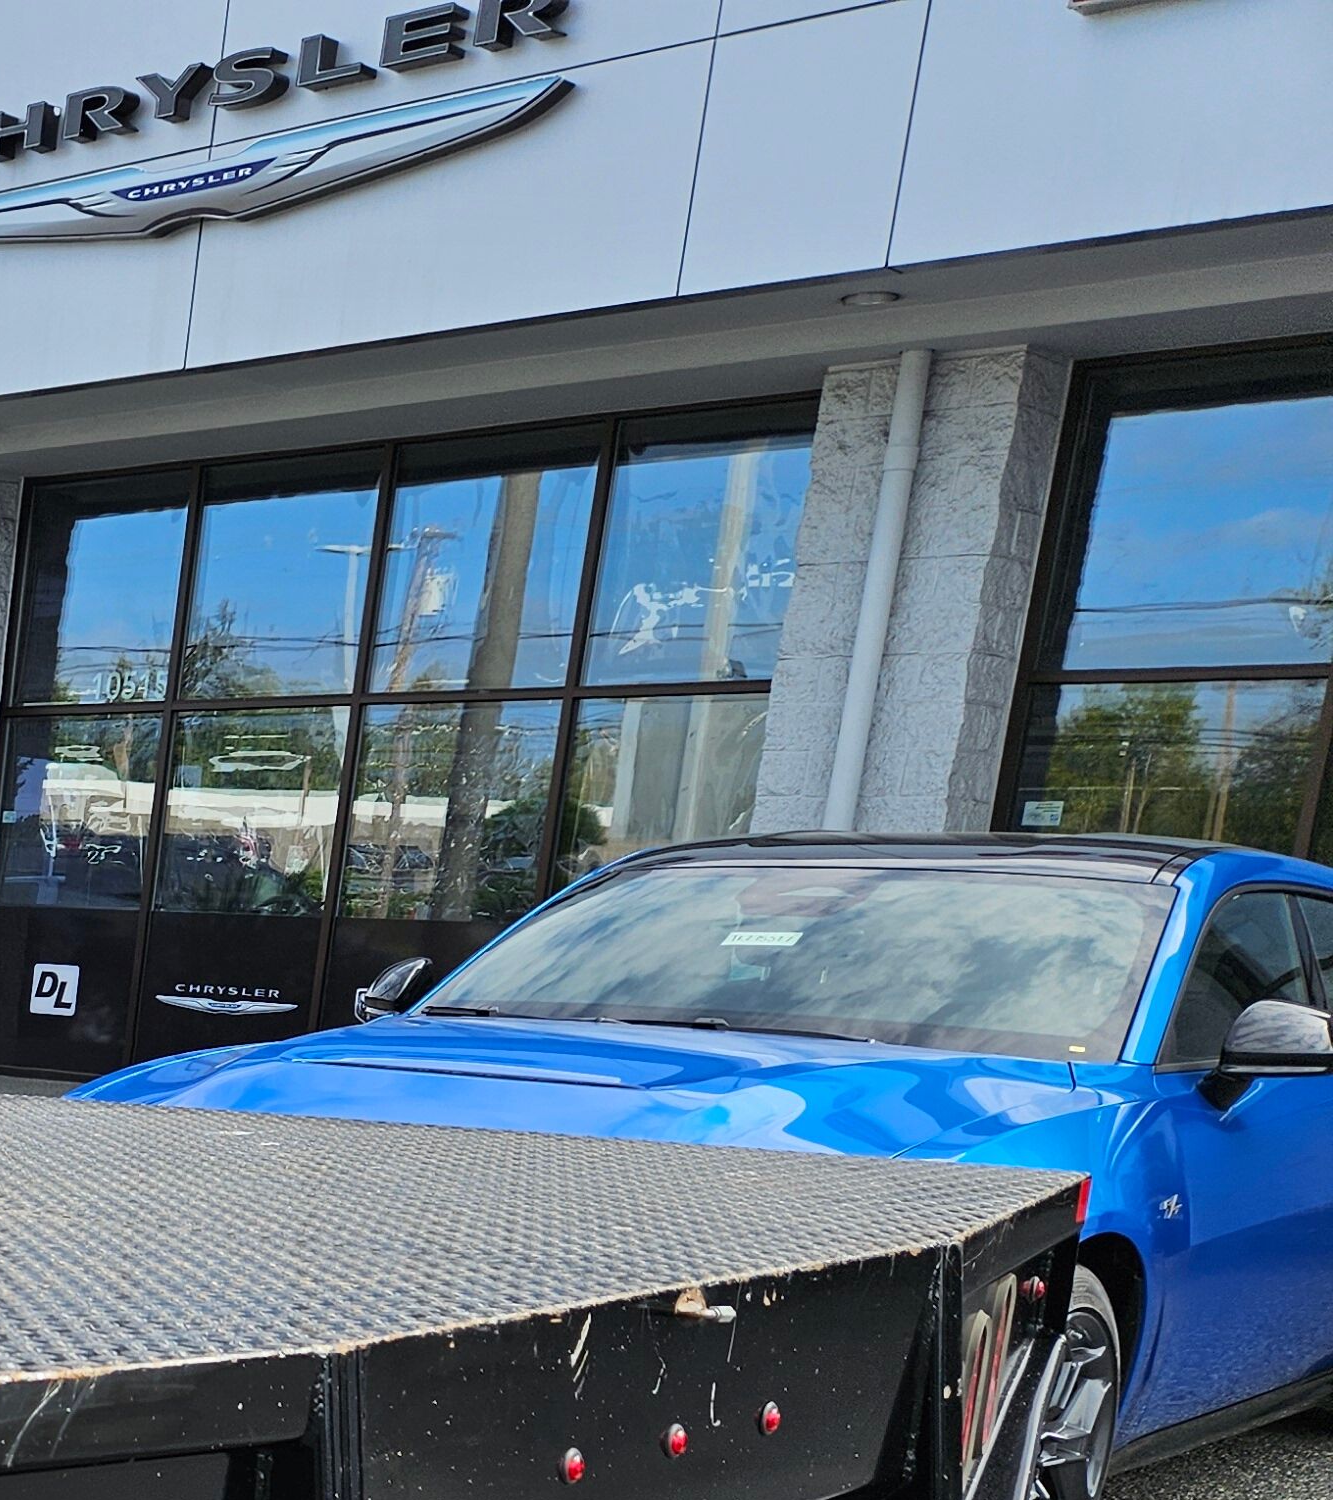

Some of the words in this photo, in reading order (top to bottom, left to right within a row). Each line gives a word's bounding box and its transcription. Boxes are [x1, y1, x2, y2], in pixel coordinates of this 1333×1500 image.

[126, 165, 254, 200] CHRYSLER
[93, 669, 168, 701] 10515
[34, 971, 72, 1010] DL
[174, 983, 281, 999] CHRYSLER
